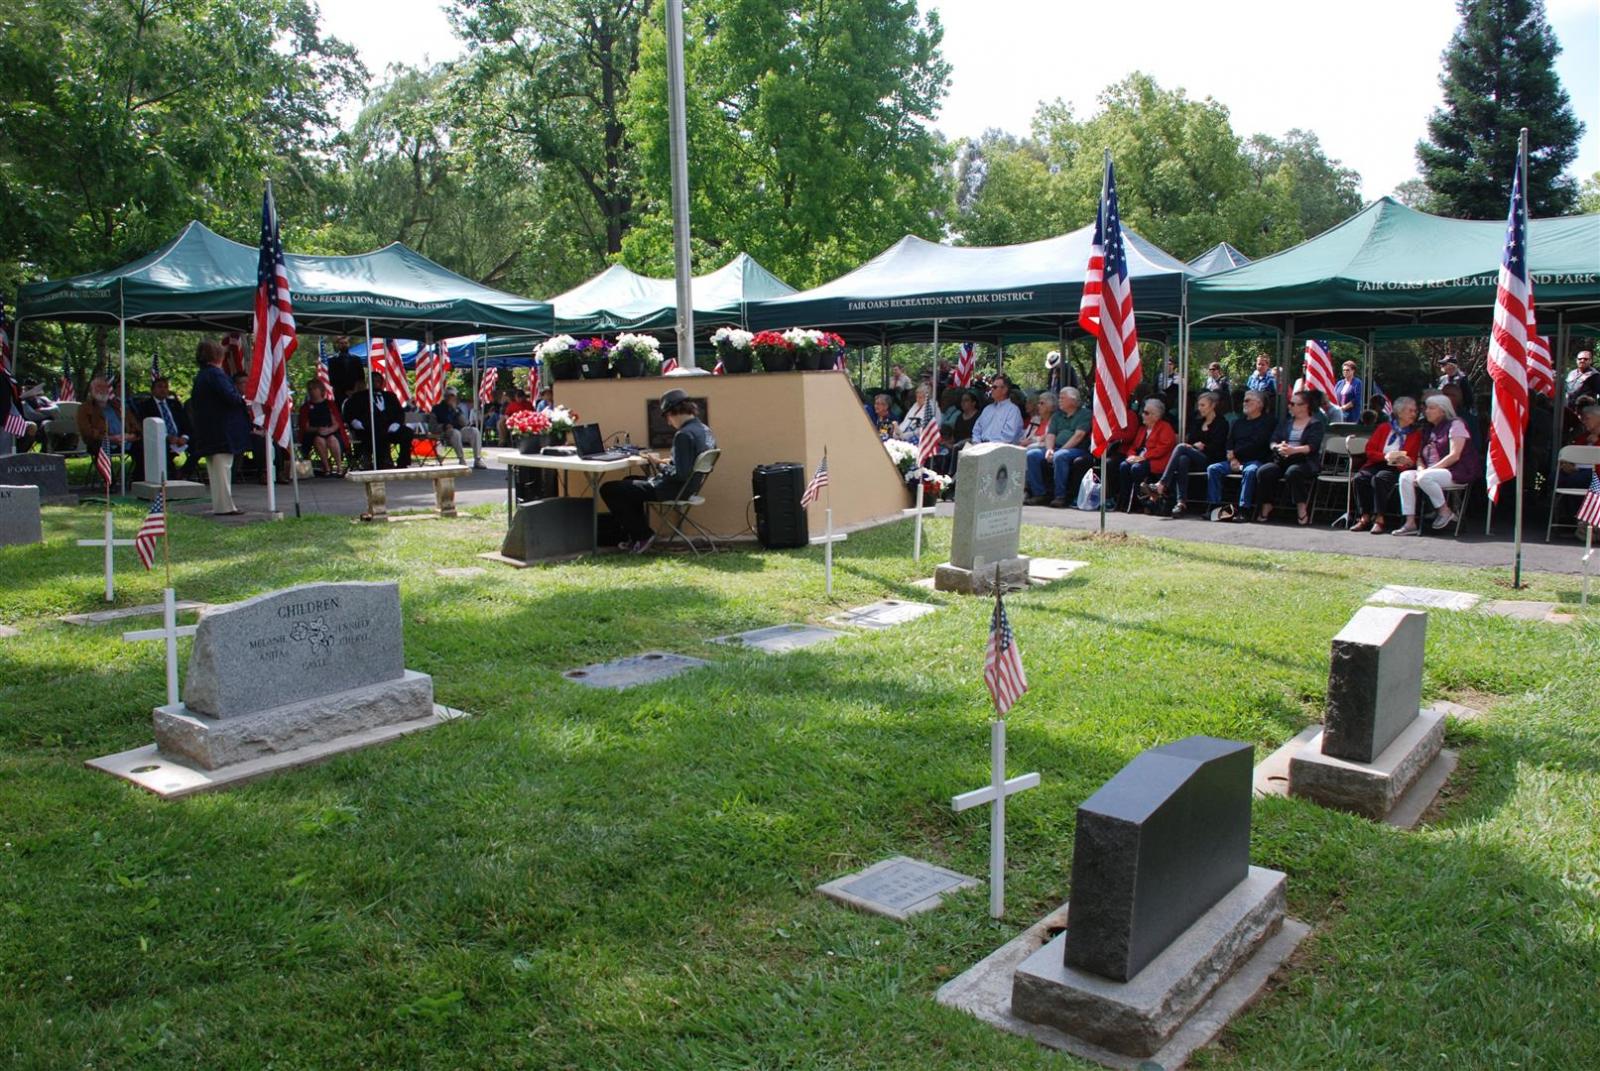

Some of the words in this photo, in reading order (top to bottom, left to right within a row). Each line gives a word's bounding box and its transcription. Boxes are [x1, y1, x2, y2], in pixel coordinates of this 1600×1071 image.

[1356, 280, 1386, 291] FAIR
[1386, 278, 1425, 291] OAKS
[1530, 274, 1551, 285] ND
[1555, 273, 1596, 284] PARK
[292, 293, 319, 303] OAKS
[319, 294, 374, 304] RECREATION
[374, 298, 394, 308] AND
[394, 300, 417, 309] PARK
[416, 301, 454, 311] DISTRICT
[848, 301, 867, 311] FAIR
[867, 299, 891, 310] OAKS
[890, 296, 943, 307] RECREATION
[944, 294, 964, 305] AND
[965, 293, 990, 304] PARK
[991, 291, 1034, 302] DISTRICT
[8, 464, 56, 473] FOWLER
[278, 598, 339, 618] CHILDREN
